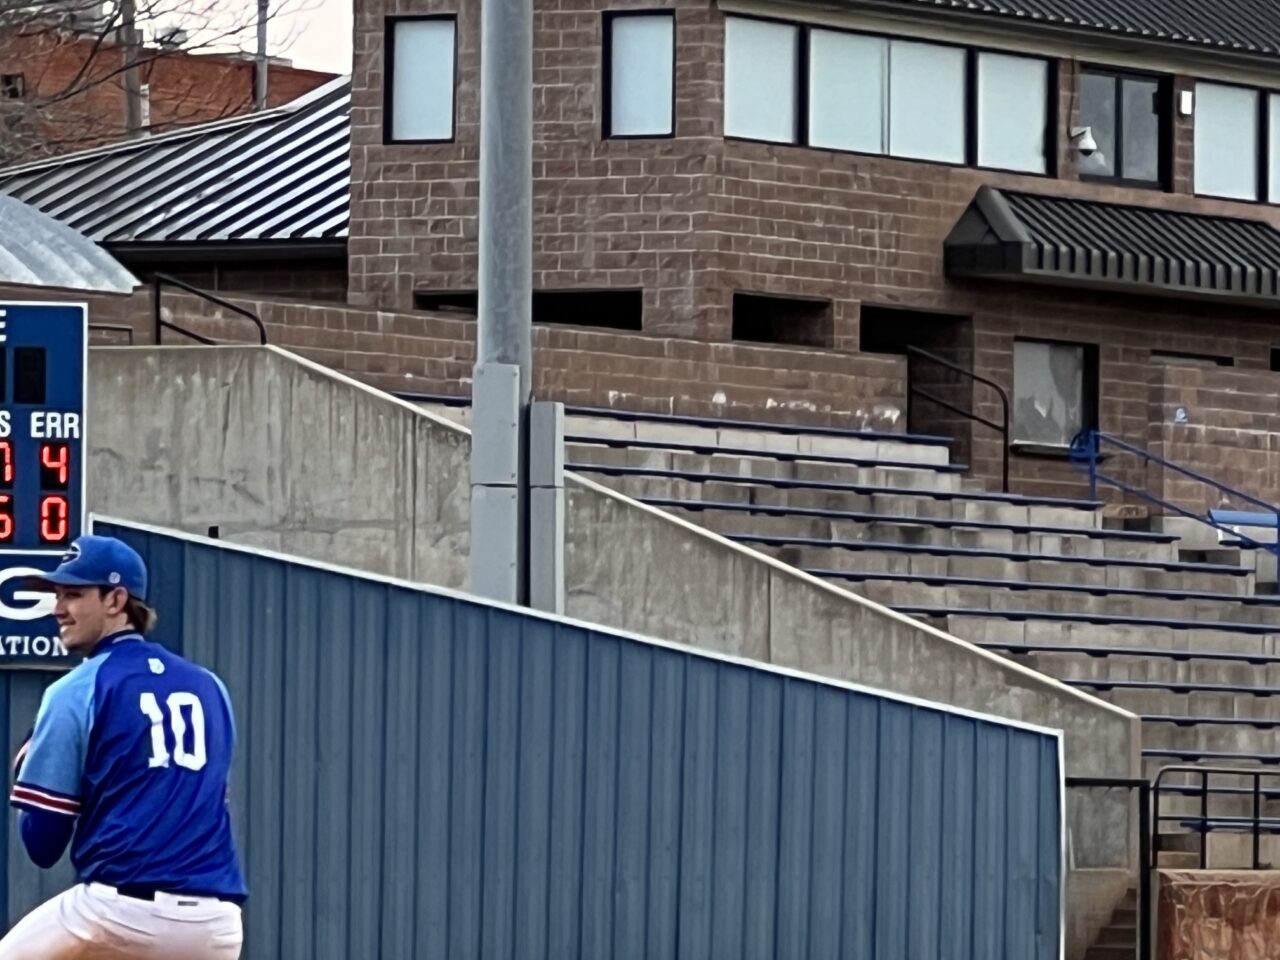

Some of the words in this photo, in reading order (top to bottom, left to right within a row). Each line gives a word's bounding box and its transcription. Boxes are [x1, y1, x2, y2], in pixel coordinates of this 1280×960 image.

[31, 412, 79, 438] ERR
[43, 447, 66, 483] 4
[42, 497, 66, 540] 0
[140, 692, 206, 770] 10
